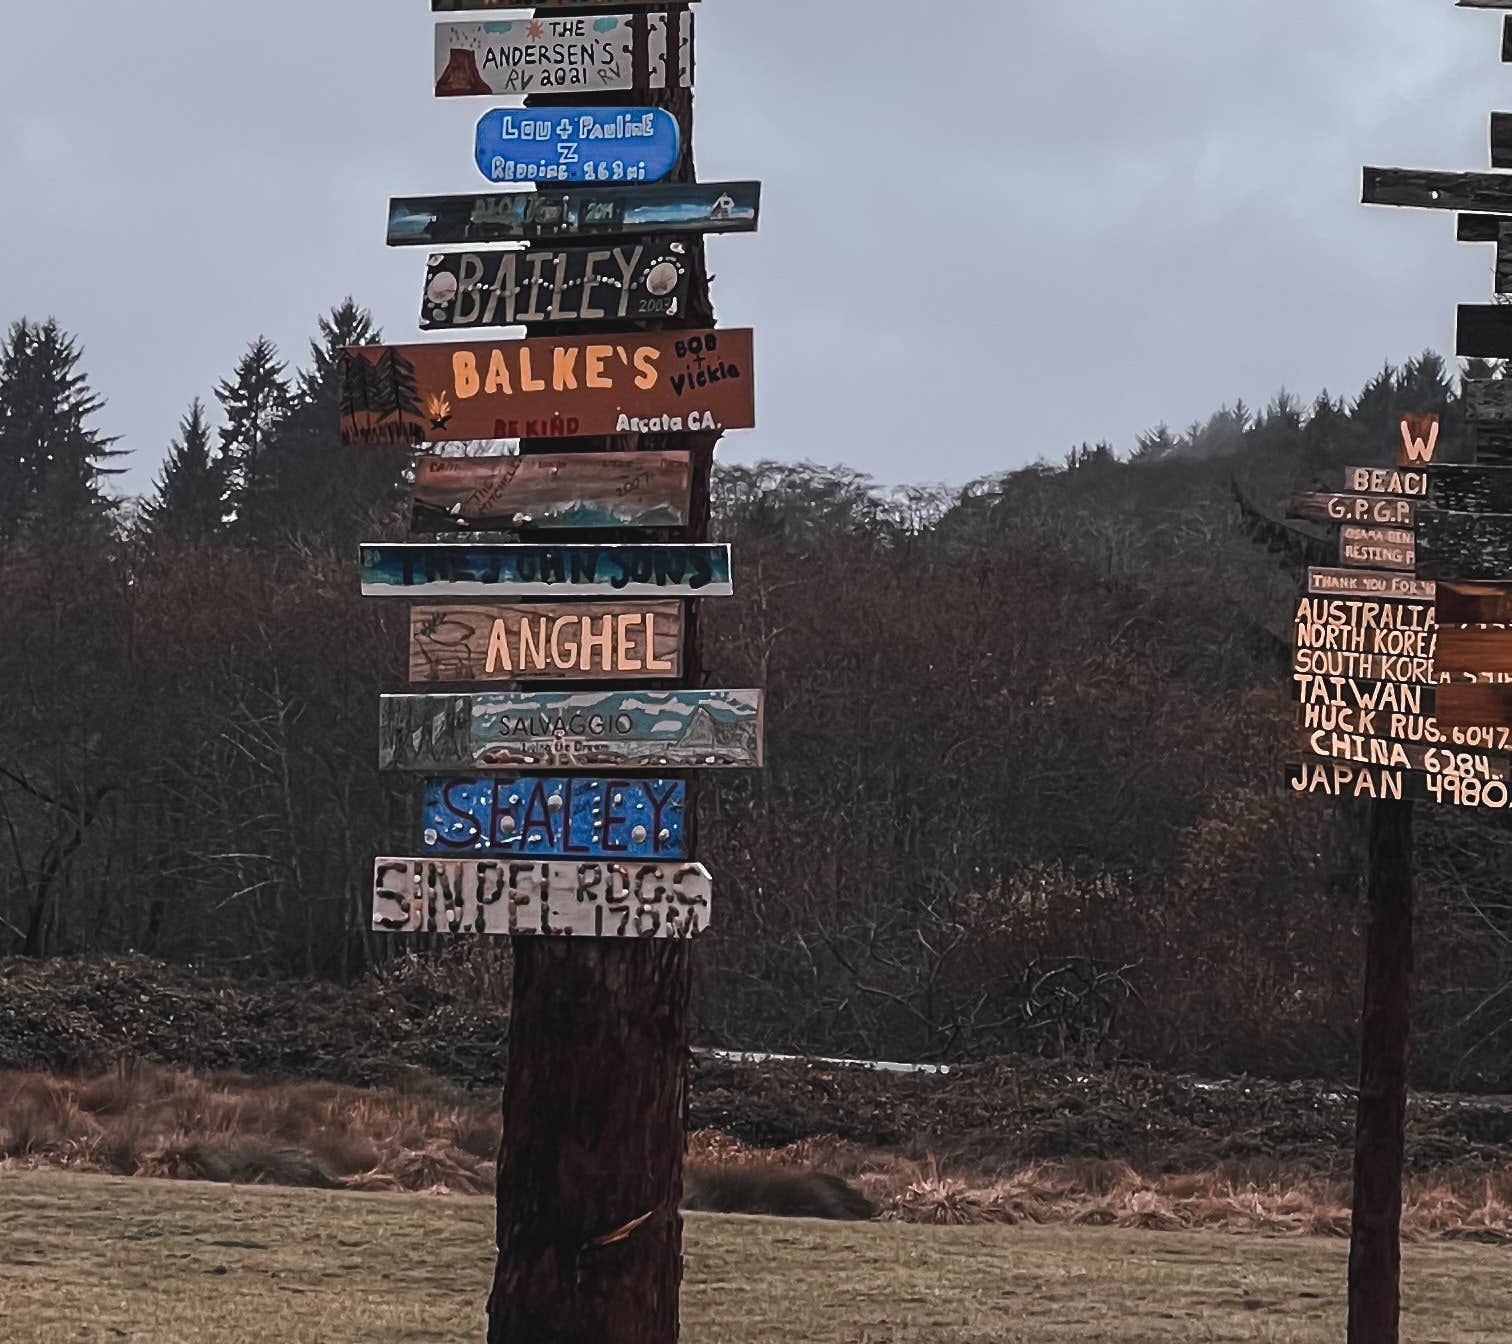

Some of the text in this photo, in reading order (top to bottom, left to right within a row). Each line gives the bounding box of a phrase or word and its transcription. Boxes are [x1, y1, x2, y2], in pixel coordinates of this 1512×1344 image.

[548, 20, 586, 38] THE
[482, 38, 616, 70] ANDERSEN'S
[504, 62, 621, 92] RV 2021 RV
[556, 142, 579, 164] Z
[451, 245, 645, 325] BAILEY
[450, 344, 663, 401] BALKE'S
[615, 411, 683, 434] Arcata
[1400, 420, 1439, 462] W
[1345, 544, 1403, 563] RESTING
[1311, 573, 1358, 590] THANK
[1363, 577, 1387, 592] YOU
[1391, 577, 1418, 595] FOR
[1295, 597, 1439, 632] AUSTRALIA
[484, 612, 673, 674] ANGHEL
[1297, 622, 1366, 653] NORTH
[1294, 648, 1374, 679] SOUTH
[1292, 672, 1422, 715] TAIWAN
[499, 713, 633, 737] SALVAGGIO
[1304, 702, 1377, 736] HUCK
[1309, 729, 1412, 770] CHINA
[1291, 762, 1403, 801] JAPAN
[434, 777, 680, 853] SEALEY
